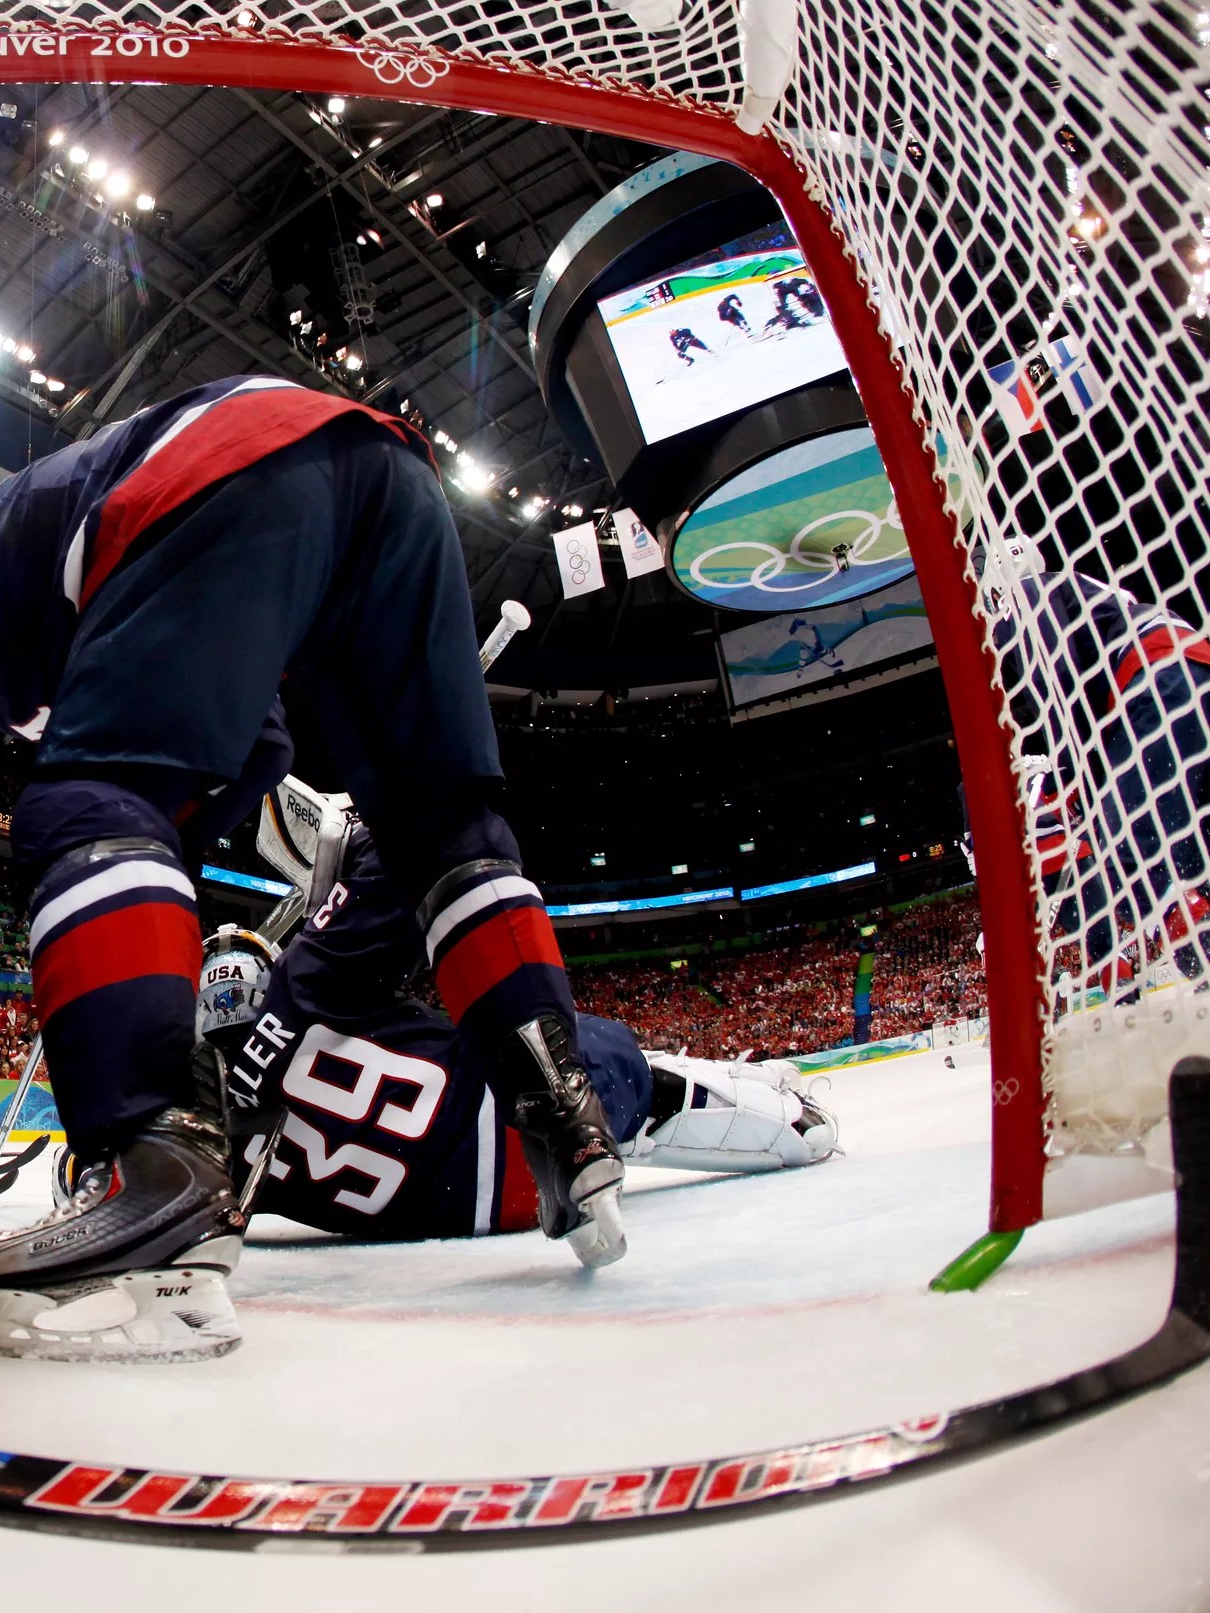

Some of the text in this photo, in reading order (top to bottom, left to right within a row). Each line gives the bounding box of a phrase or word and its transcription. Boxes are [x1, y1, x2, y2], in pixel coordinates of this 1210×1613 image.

[90, 35, 190, 58] 2010
[207, 965, 244, 984] USA
[243, 1023, 447, 1216] 39
[23, 1429, 894, 1533] WARRIOR
